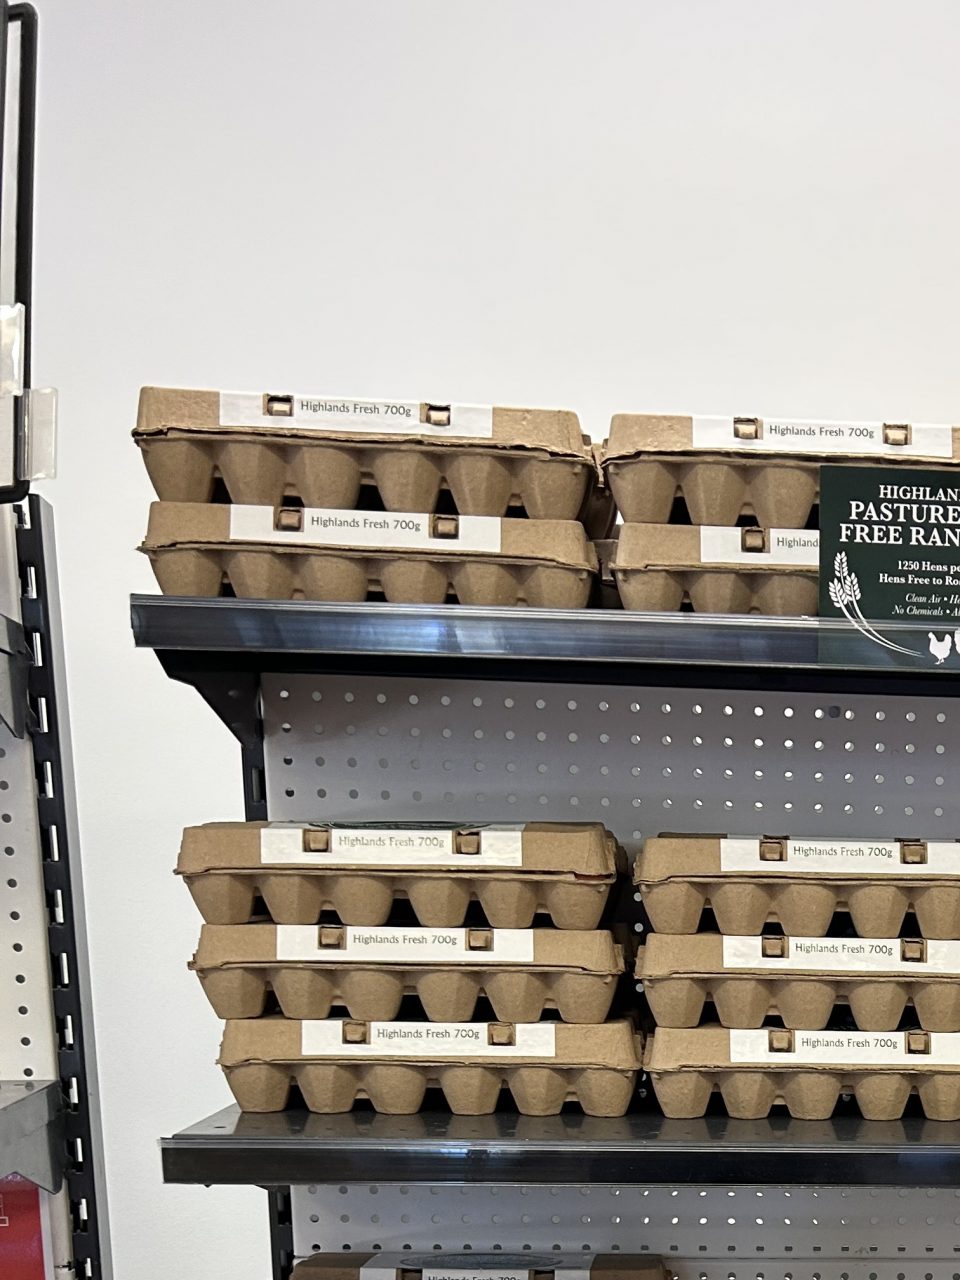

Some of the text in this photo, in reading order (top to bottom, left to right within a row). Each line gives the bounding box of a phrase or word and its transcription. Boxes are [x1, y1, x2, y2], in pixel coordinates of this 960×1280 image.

[301, 400, 411, 417] Highlands Fresh 700g
[770, 425, 874, 439] Highlands Fresh 700g
[849, 501, 960, 524] PASTURE
[312, 516, 421, 532] Highlands Fresh 700g
[840, 523, 903, 545] FREE
[776, 537, 820, 548] Highland
[898, 560, 919, 571] 1250
[921, 562, 948, 572] Hens
[880, 574, 905, 584] Hens
[908, 575, 930, 584] Free
[933, 576, 942, 585] to
[905, 593, 926, 602] Clean
[927, 594, 940, 603] Air
[892, 606, 904, 615] No
[906, 606, 944, 616] Chemicals
[794, 846, 892, 858] Highlands Fresh 700g
[353, 934, 457, 946] Highlands Fresh 700g
[796, 943, 893, 956] Highlands Fresh 700g
